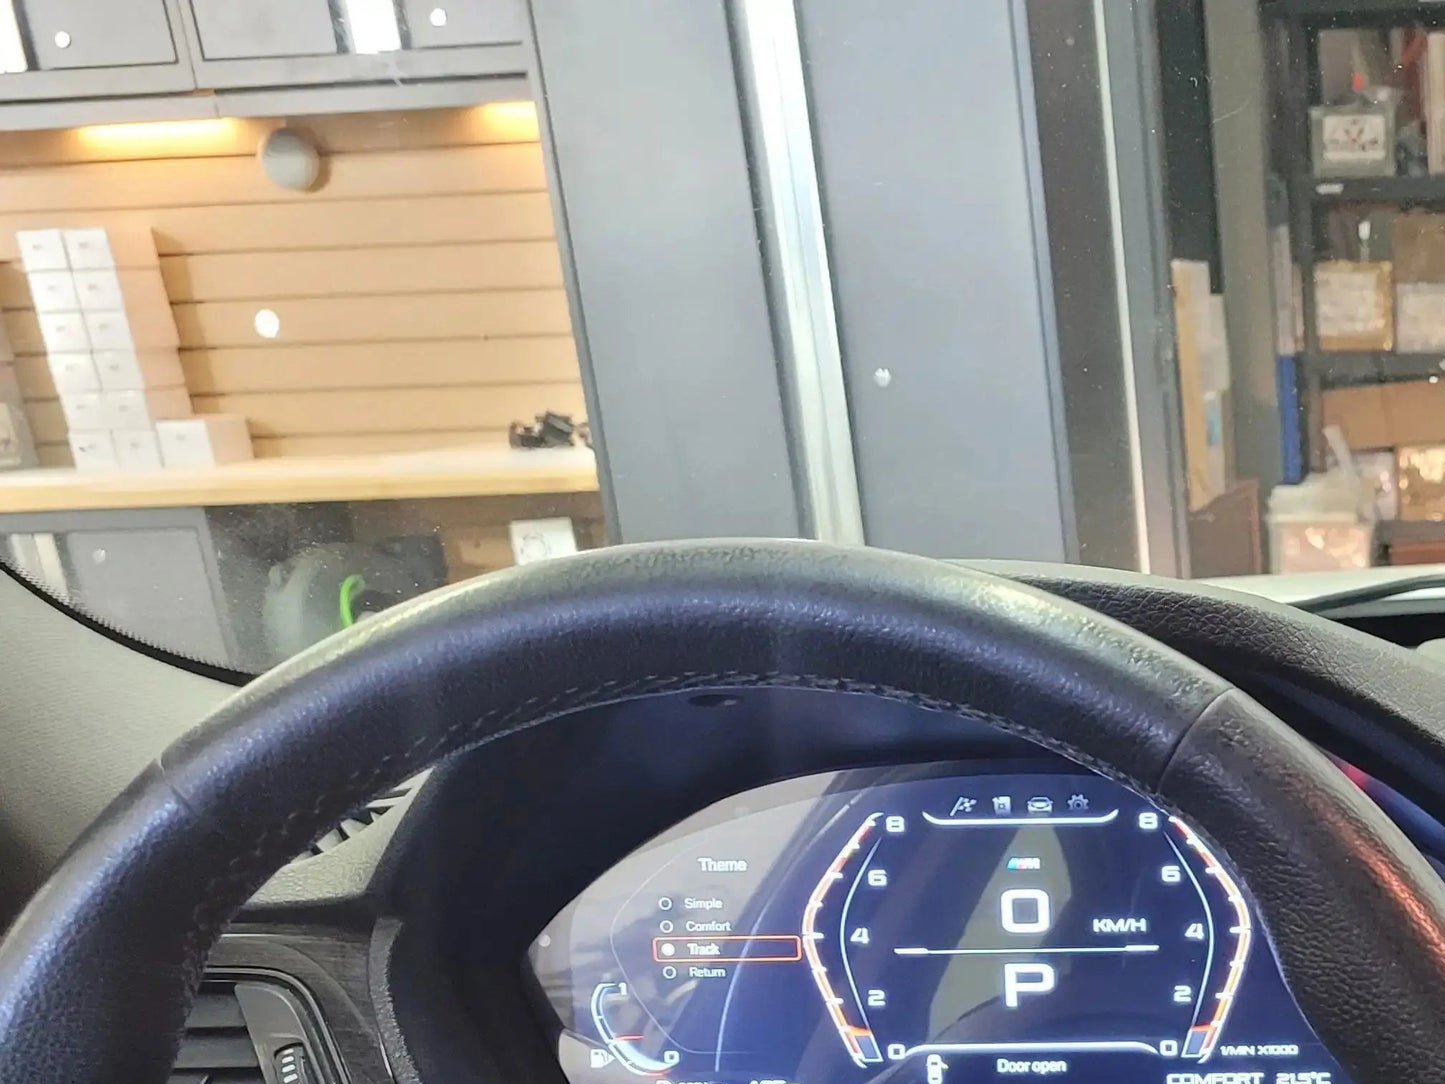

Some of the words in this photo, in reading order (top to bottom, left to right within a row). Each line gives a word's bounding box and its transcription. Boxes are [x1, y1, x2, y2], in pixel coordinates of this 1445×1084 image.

[886, 816, 905, 832] 8
[1139, 813, 1158, 829] 8
[697, 857, 748, 873] Theme
[868, 870, 887, 886] 6
[1161, 866, 1180, 882] 6
[684, 897, 723, 910] Simple
[686, 920, 731, 932] Comfort
[1093, 918, 1146, 933] KM/H
[1185, 924, 1203, 940] 4
[851, 928, 869, 944] 4
[687, 943, 720, 956] Track
[689, 966, 726, 978] Return
[1004, 963, 1055, 1008] P
[867, 990, 886, 1006] 2
[1174, 986, 1192, 1002] 2
[1160, 1039, 1178, 1056] 0
[997, 1058, 1030, 1073] Door
[1031, 1060, 1067, 1074] open
